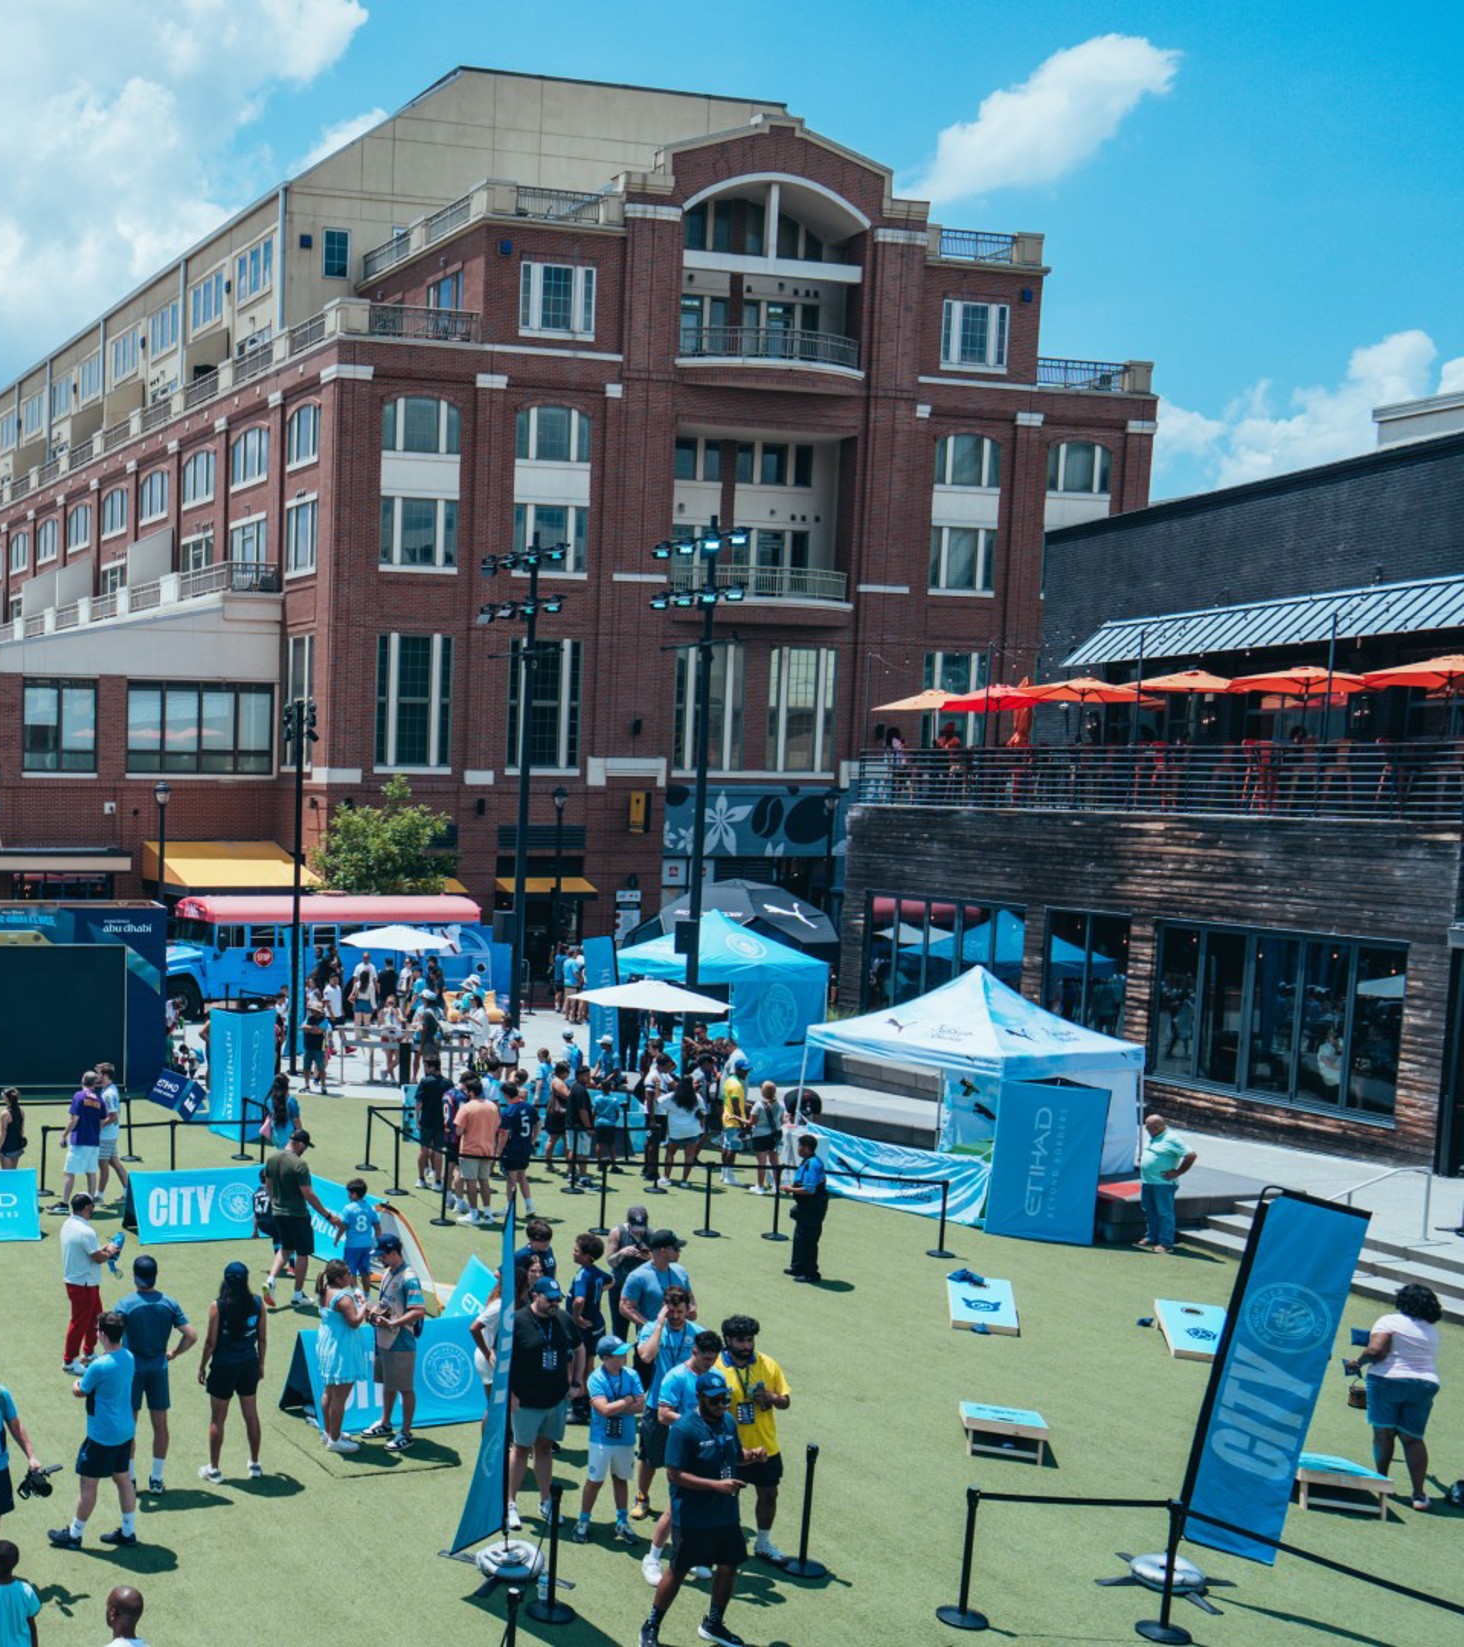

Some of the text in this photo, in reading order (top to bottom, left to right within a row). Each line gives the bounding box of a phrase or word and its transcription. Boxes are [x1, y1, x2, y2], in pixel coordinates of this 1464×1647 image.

[102, 923, 152, 933] abu dhabi
[257, 952, 271, 961] STOP
[520, 1115, 530, 1137] 5
[1024, 1107, 1053, 1217] ETIHAD
[148, 1184, 216, 1227] CITY
[254, 1196, 270, 1214] 47
[355, 1214, 367, 1233] 8
[1211, 1341, 1314, 1481] CITY
